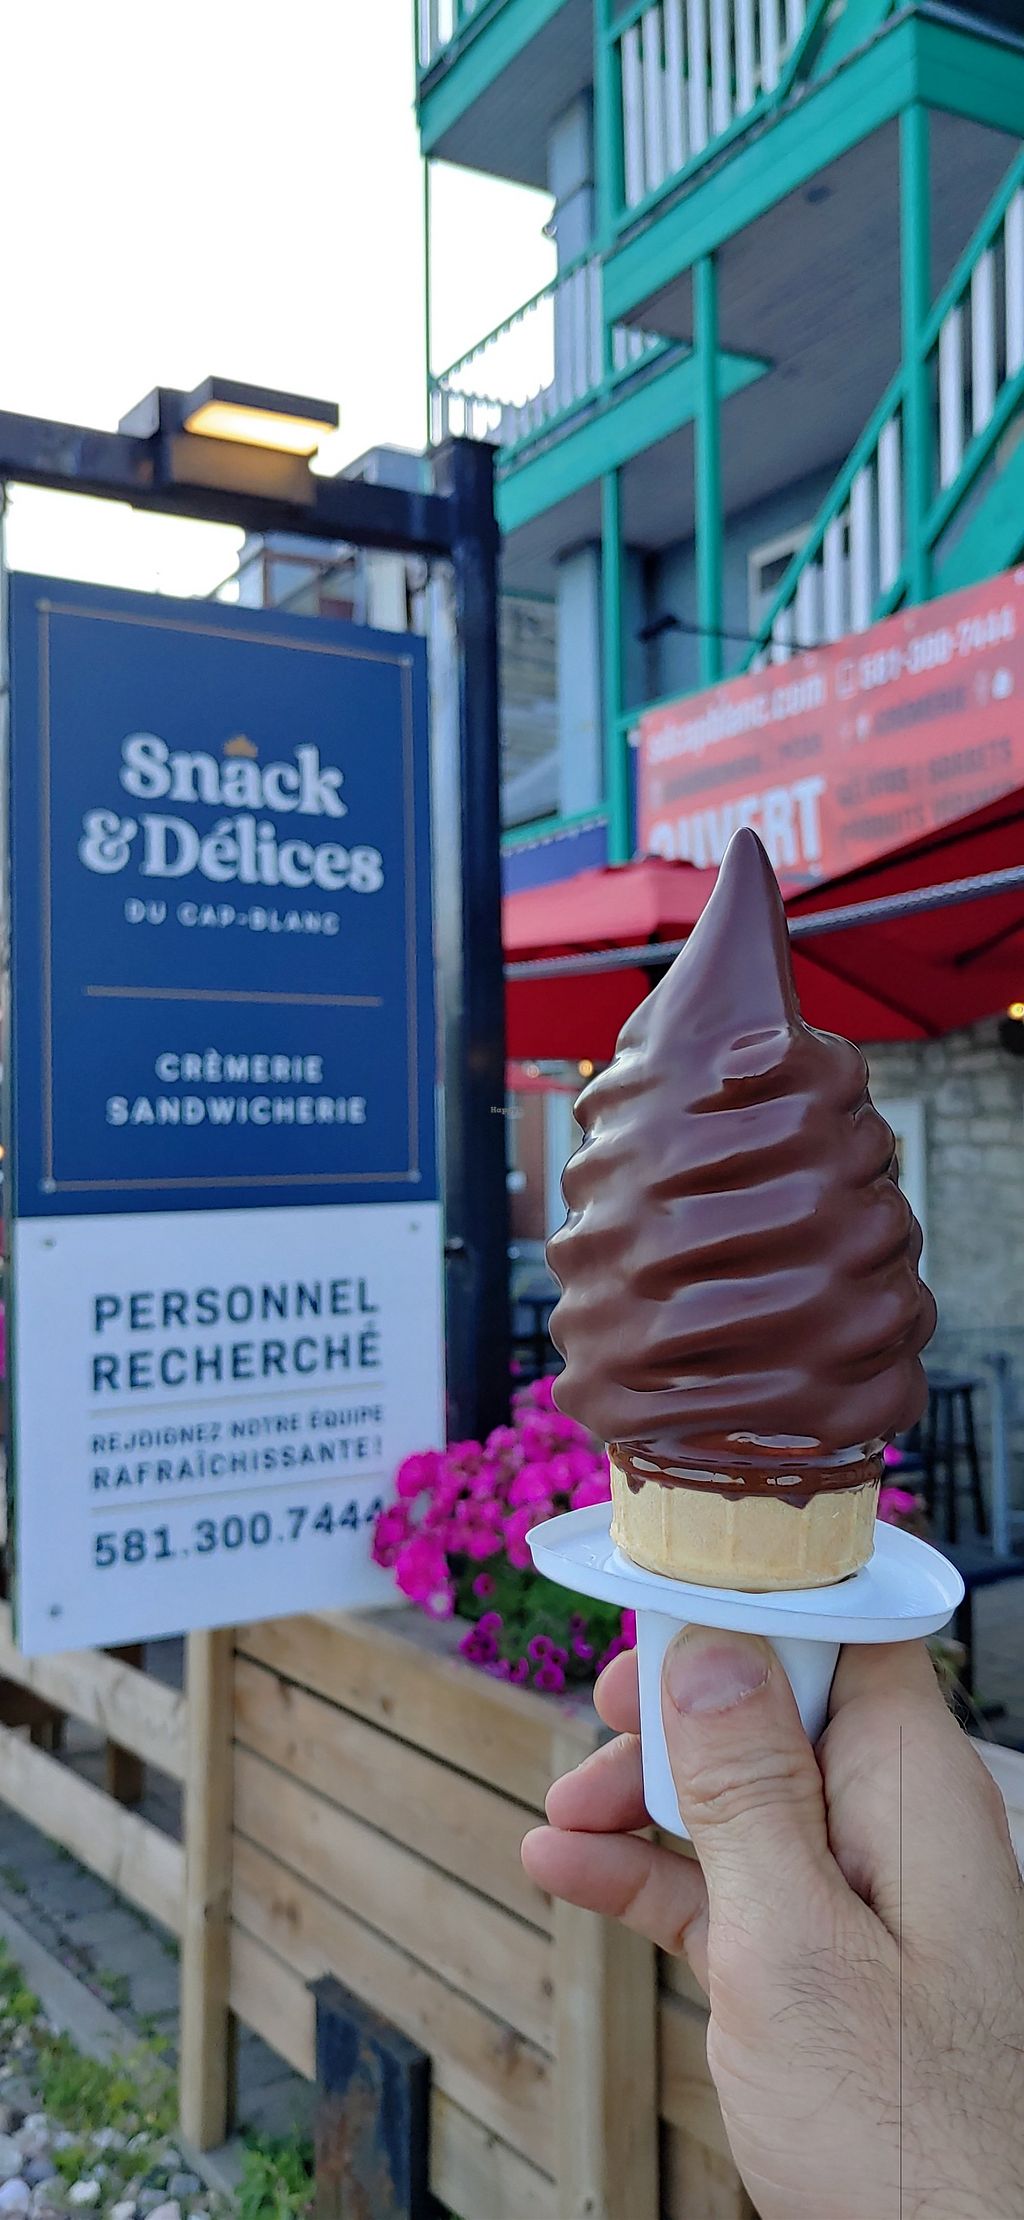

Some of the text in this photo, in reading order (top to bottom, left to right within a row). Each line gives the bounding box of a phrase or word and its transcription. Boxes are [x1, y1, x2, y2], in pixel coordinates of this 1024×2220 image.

[119, 732, 348, 817] Snack
[77, 808, 384, 893] & Délices
[124, 898, 341, 936] DU CAP-BLANC
[155, 1048, 323, 1083] CRÈMERIE
[105, 1096, 367, 1126] SANDWICHERIE
[93, 1278, 380, 1332] PERSONNEL
[92, 1320, 382, 1392] RECHERCHÉ
[91, 1421, 222, 1455] REJOIGNEZ
[230, 1412, 301, 1438] NOTRE
[92, 1434, 383, 1491] RAFRAÎCHISSANTE!
[95, 1495, 384, 1568] 581.300.7444
